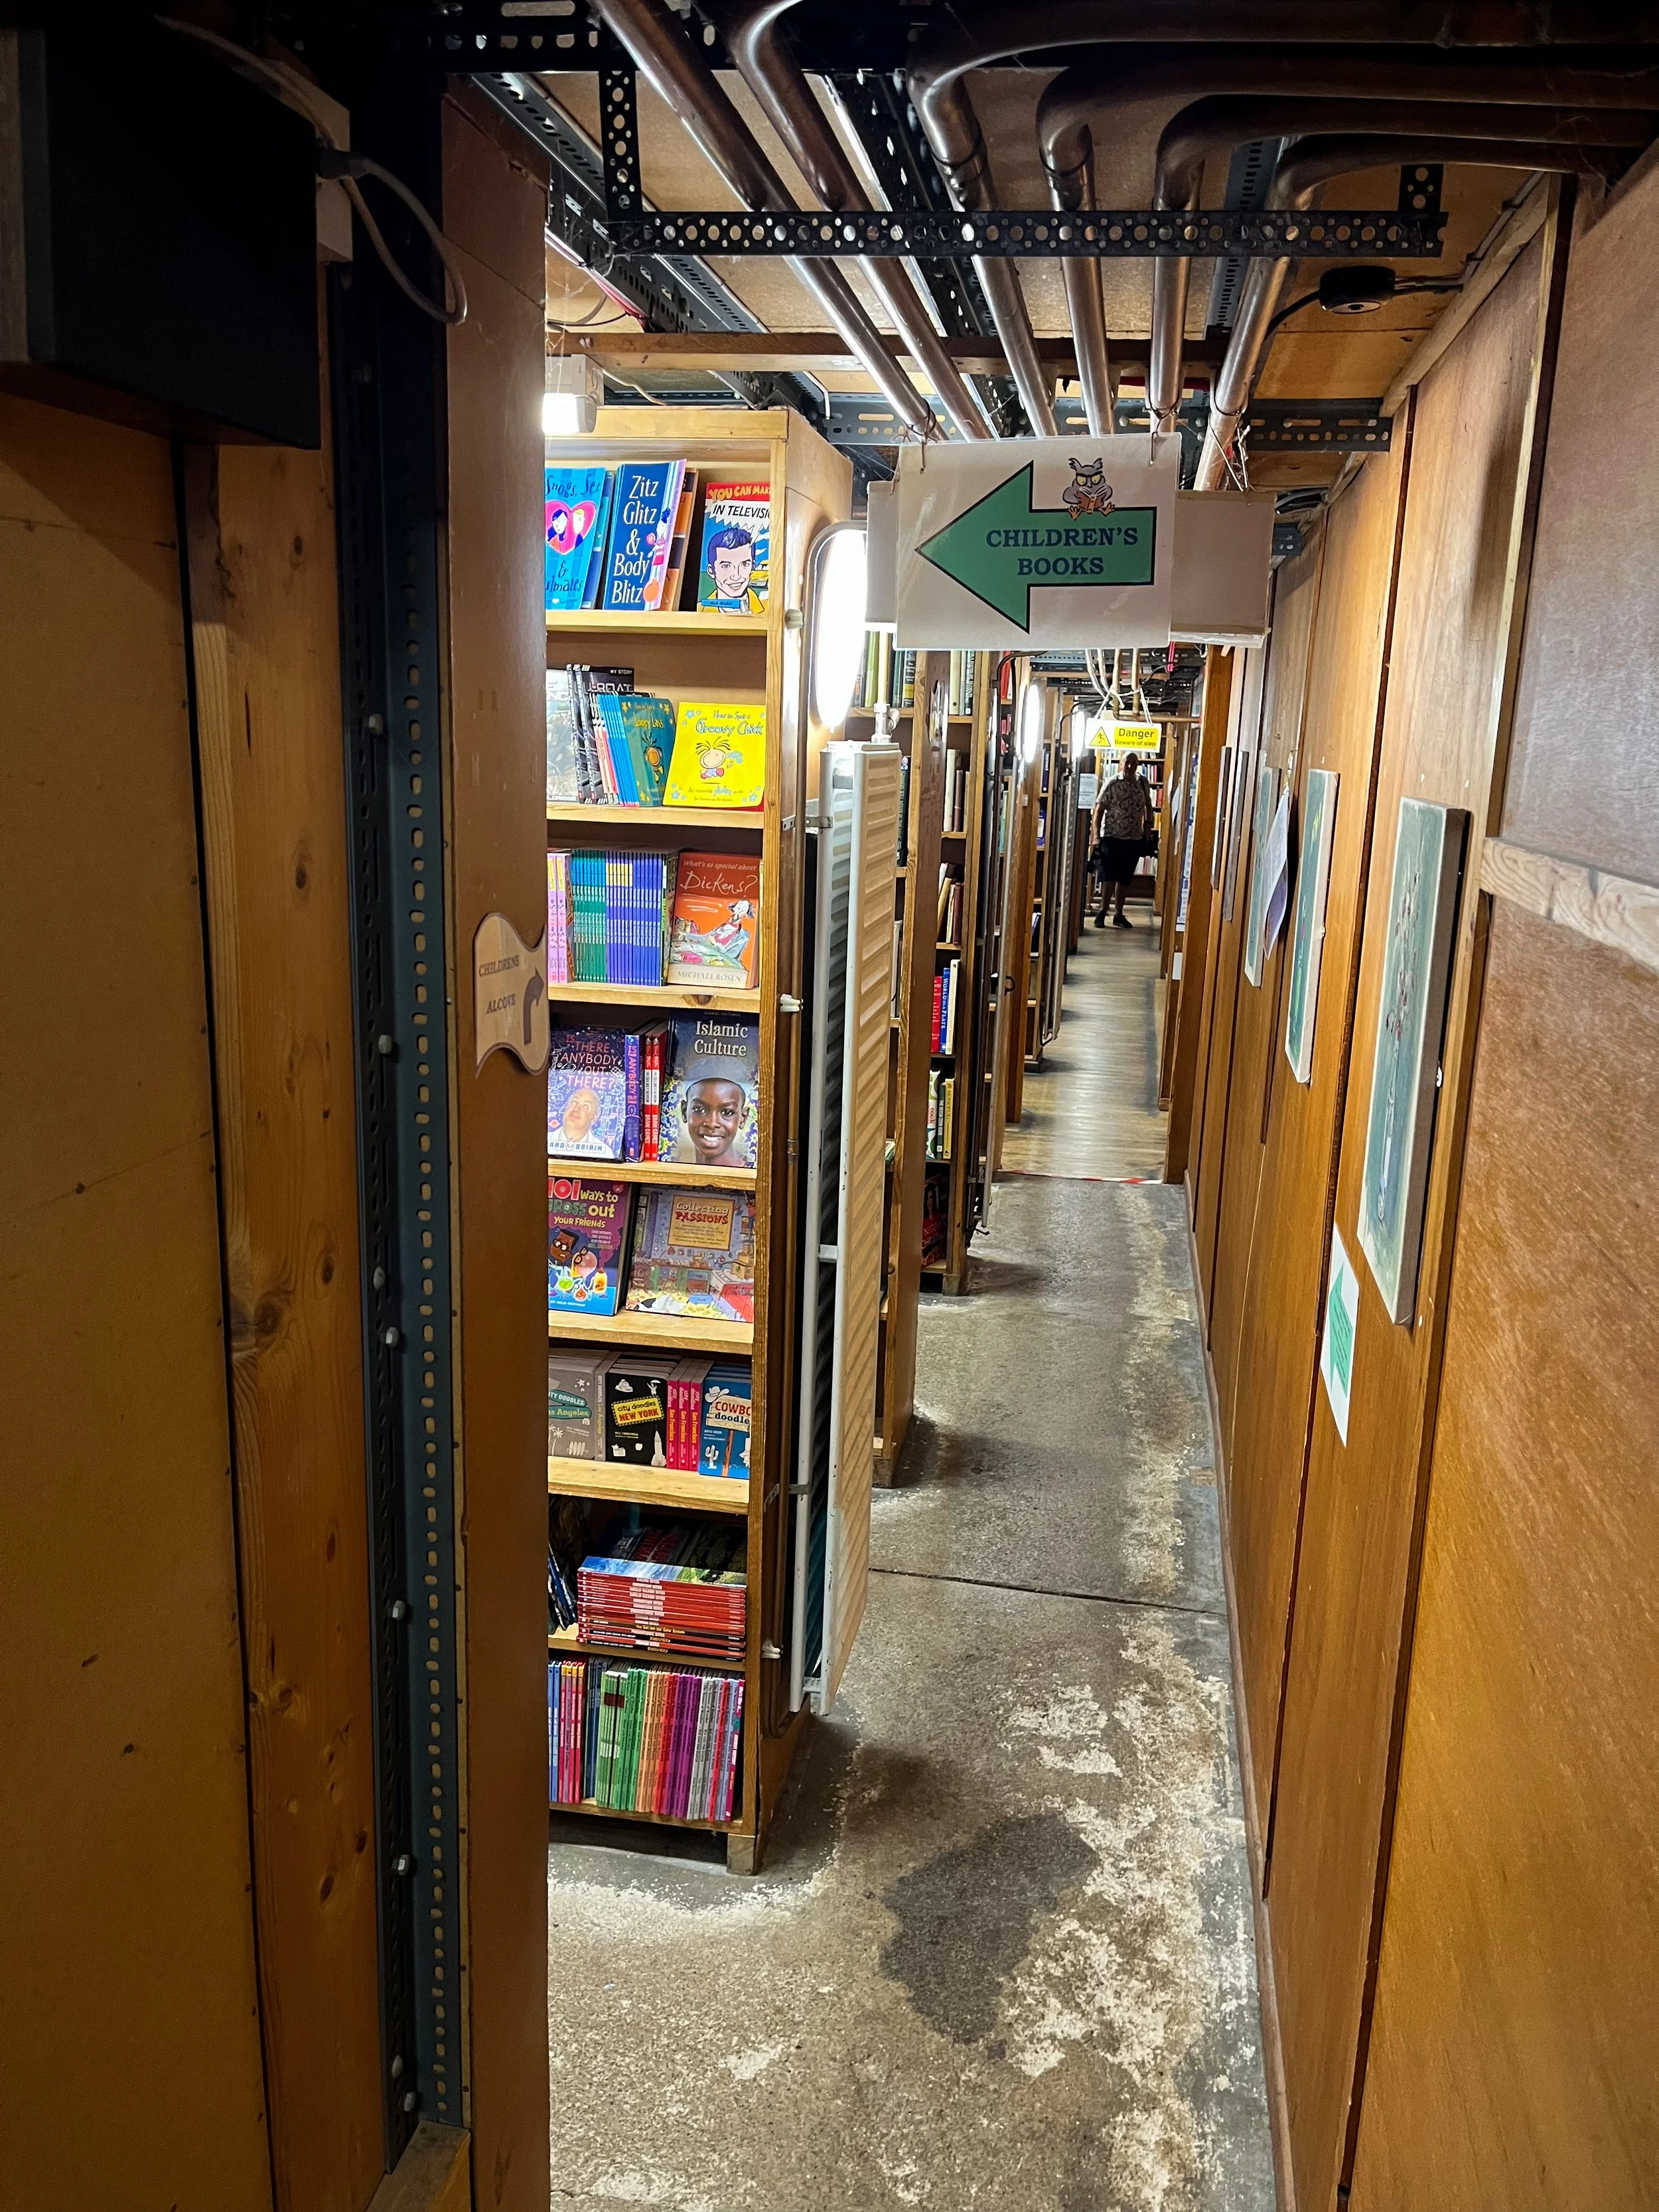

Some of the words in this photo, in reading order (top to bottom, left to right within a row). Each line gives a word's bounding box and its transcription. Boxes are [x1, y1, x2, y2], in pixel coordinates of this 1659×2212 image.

[581, 474, 600, 496] Sex
[629, 475, 659, 498] Zitz
[708, 487, 733, 502] YOU
[733, 485, 753, 497] CAN
[752, 484, 770, 496] MAK
[623, 500, 658, 524] Glitz
[713, 504, 725, 515] IN
[727, 505, 770, 519] TELEVISI
[626, 528, 640, 555] &
[986, 527, 1138, 548] CHILDREN'S
[614, 552, 650, 583] Body
[1017, 557, 1104, 575] BOOKS
[611, 579, 644, 603] Blitz
[696, 717, 735, 737] Groovy
[738, 721, 763, 735] Chick
[1119, 728, 1155, 739] Danger
[680, 871, 758, 897] Dickens?
[478, 955, 520, 977] CHILDRENS
[677, 970, 715, 980] MICHAEL
[716, 973, 742, 982] ROSEN
[486, 993, 516, 1014] ALCOVE
[695, 1020, 748, 1038] Islamic
[566, 1034, 575, 1043] IS
[575, 1041, 610, 1053] THERE
[694, 1039, 747, 1057] Culture
[560, 1053, 619, 1065] ANYBODY
[584, 1065, 605, 1076] OUT
[567, 1075, 615, 1089] THERE?
[548, 1177, 581, 1201] 101
[580, 1190, 605, 1201] ways
[606, 1191, 618, 1203] to
[588, 1204, 615, 1218] out
[675, 1211, 729, 1225] PASSIONS
[677, 1202, 729, 1216] Collecting
[559, 1394, 584, 1406] DOODLES
[632, 1401, 656, 1410] doodles
[556, 1408, 589, 1418] Angeles
[618, 1412, 636, 1422] NEW
[638, 1408, 659, 1418] YORK
